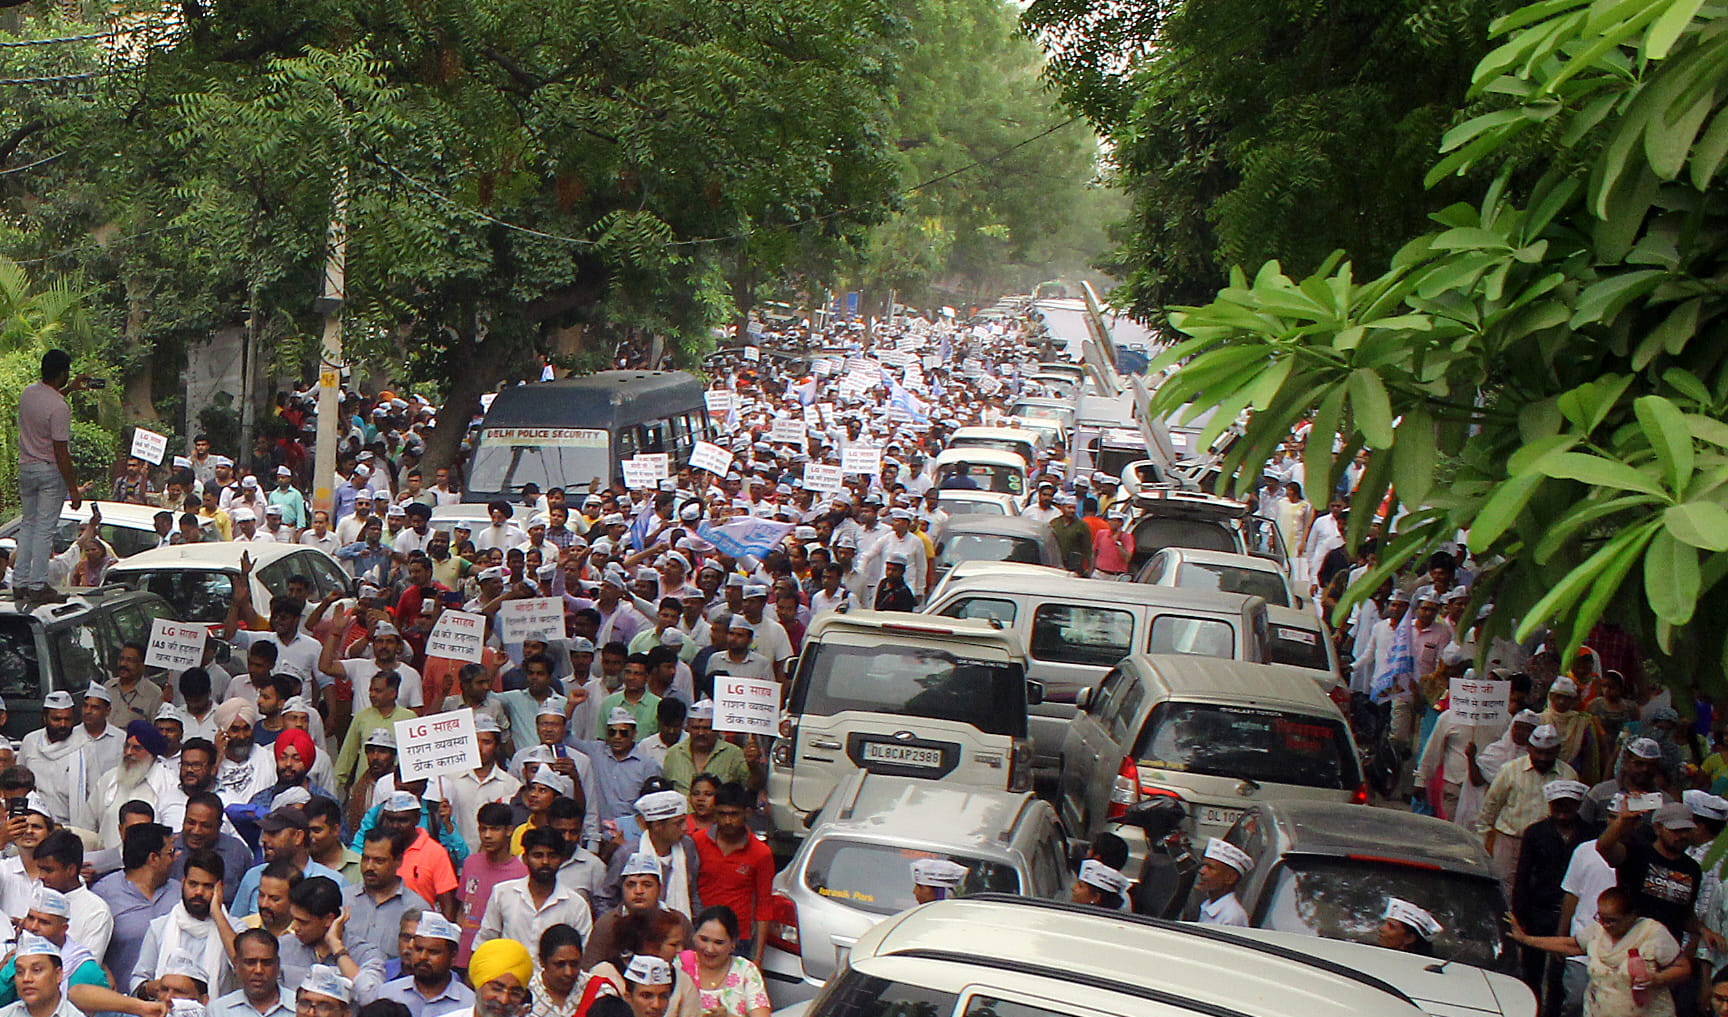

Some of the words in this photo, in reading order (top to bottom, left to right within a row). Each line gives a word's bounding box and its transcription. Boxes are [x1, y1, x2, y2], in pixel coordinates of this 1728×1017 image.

[487, 429, 514, 438] DELHI
[517, 430, 548, 438] POLICE
[552, 430, 600, 439] SECURITY
[162, 626, 176, 636] LG
[152, 640, 166, 649] IAS
[727, 684, 744, 696] LG
[749, 685, 773, 698] साहब
[722, 699, 746, 711] राशन
[409, 725, 427, 738] LG
[432, 719, 460, 733] साहब
[405, 743, 432, 755] राशन
[434, 736, 468, 750] व्यवस्था
[436, 751, 466, 767] कराओ
